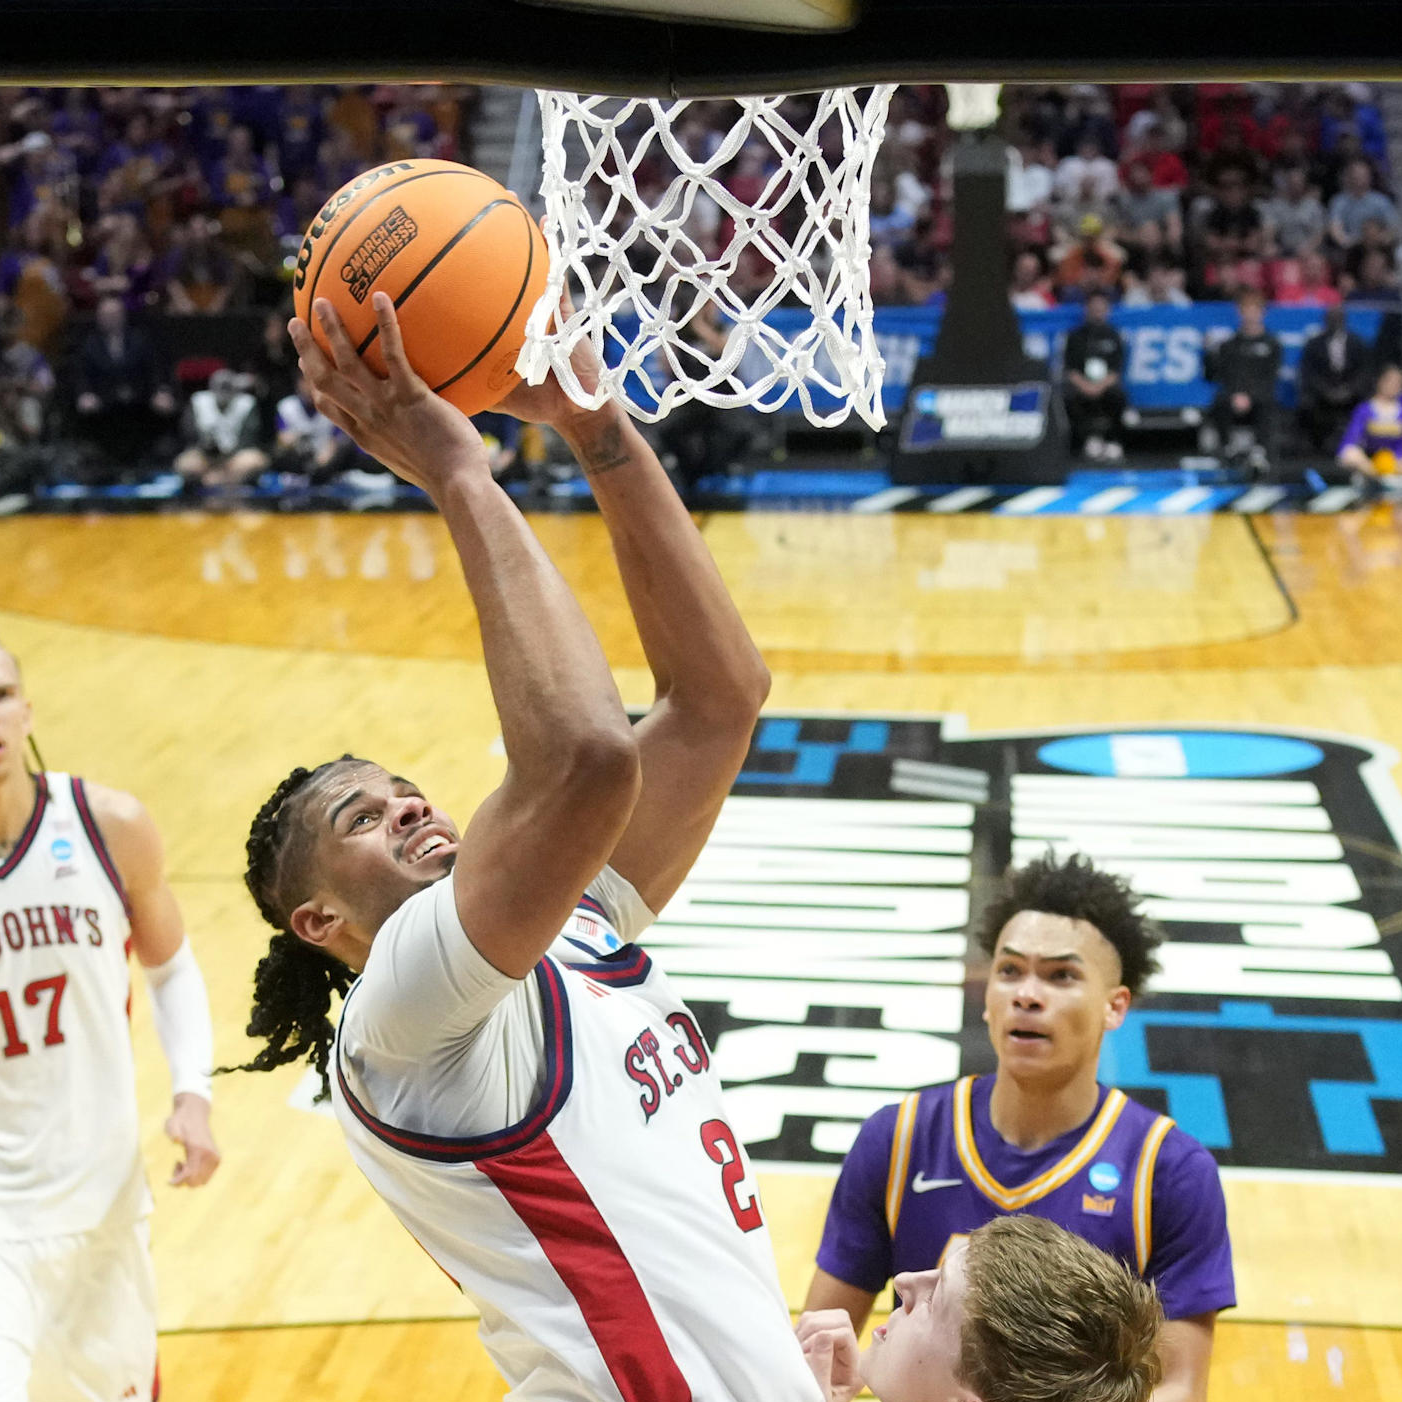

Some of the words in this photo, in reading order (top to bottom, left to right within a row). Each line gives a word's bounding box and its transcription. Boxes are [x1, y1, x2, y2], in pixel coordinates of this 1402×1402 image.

[350, 225, 389, 266] MARCH
[363, 219, 417, 275] MADNESS
[624, 1026, 683, 1125] ST.
